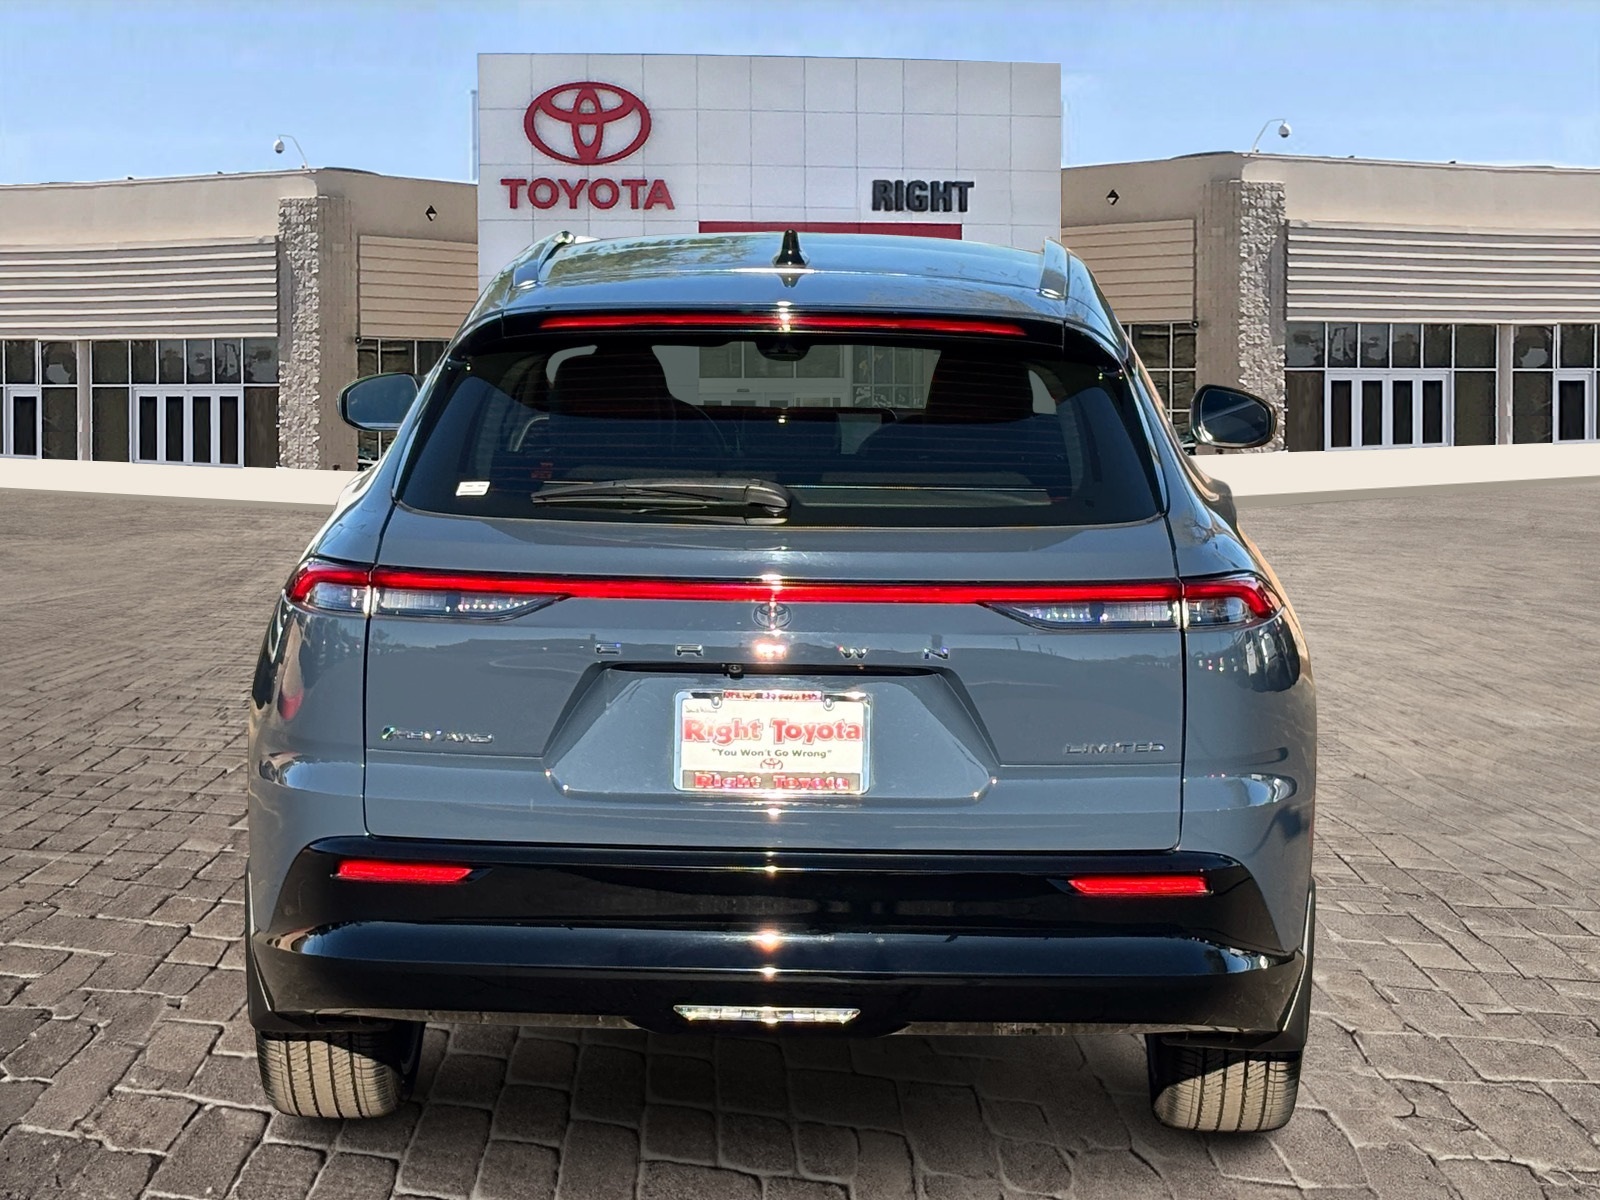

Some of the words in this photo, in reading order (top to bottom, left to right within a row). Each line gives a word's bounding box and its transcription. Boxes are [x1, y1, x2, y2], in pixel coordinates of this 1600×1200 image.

[500, 179, 675, 210] TOYOTA
[872, 180, 974, 212] RIGHT
[594, 642, 950, 660] CRWN
[682, 717, 763, 746] Right
[770, 718, 863, 745] Toyota
[740, 749, 771, 757] Won't
[774, 749, 789, 758] Go
[1065, 742, 1166, 754] LIMITED
[694, 772, 762, 790] Right
[773, 774, 849, 790] Toyota
